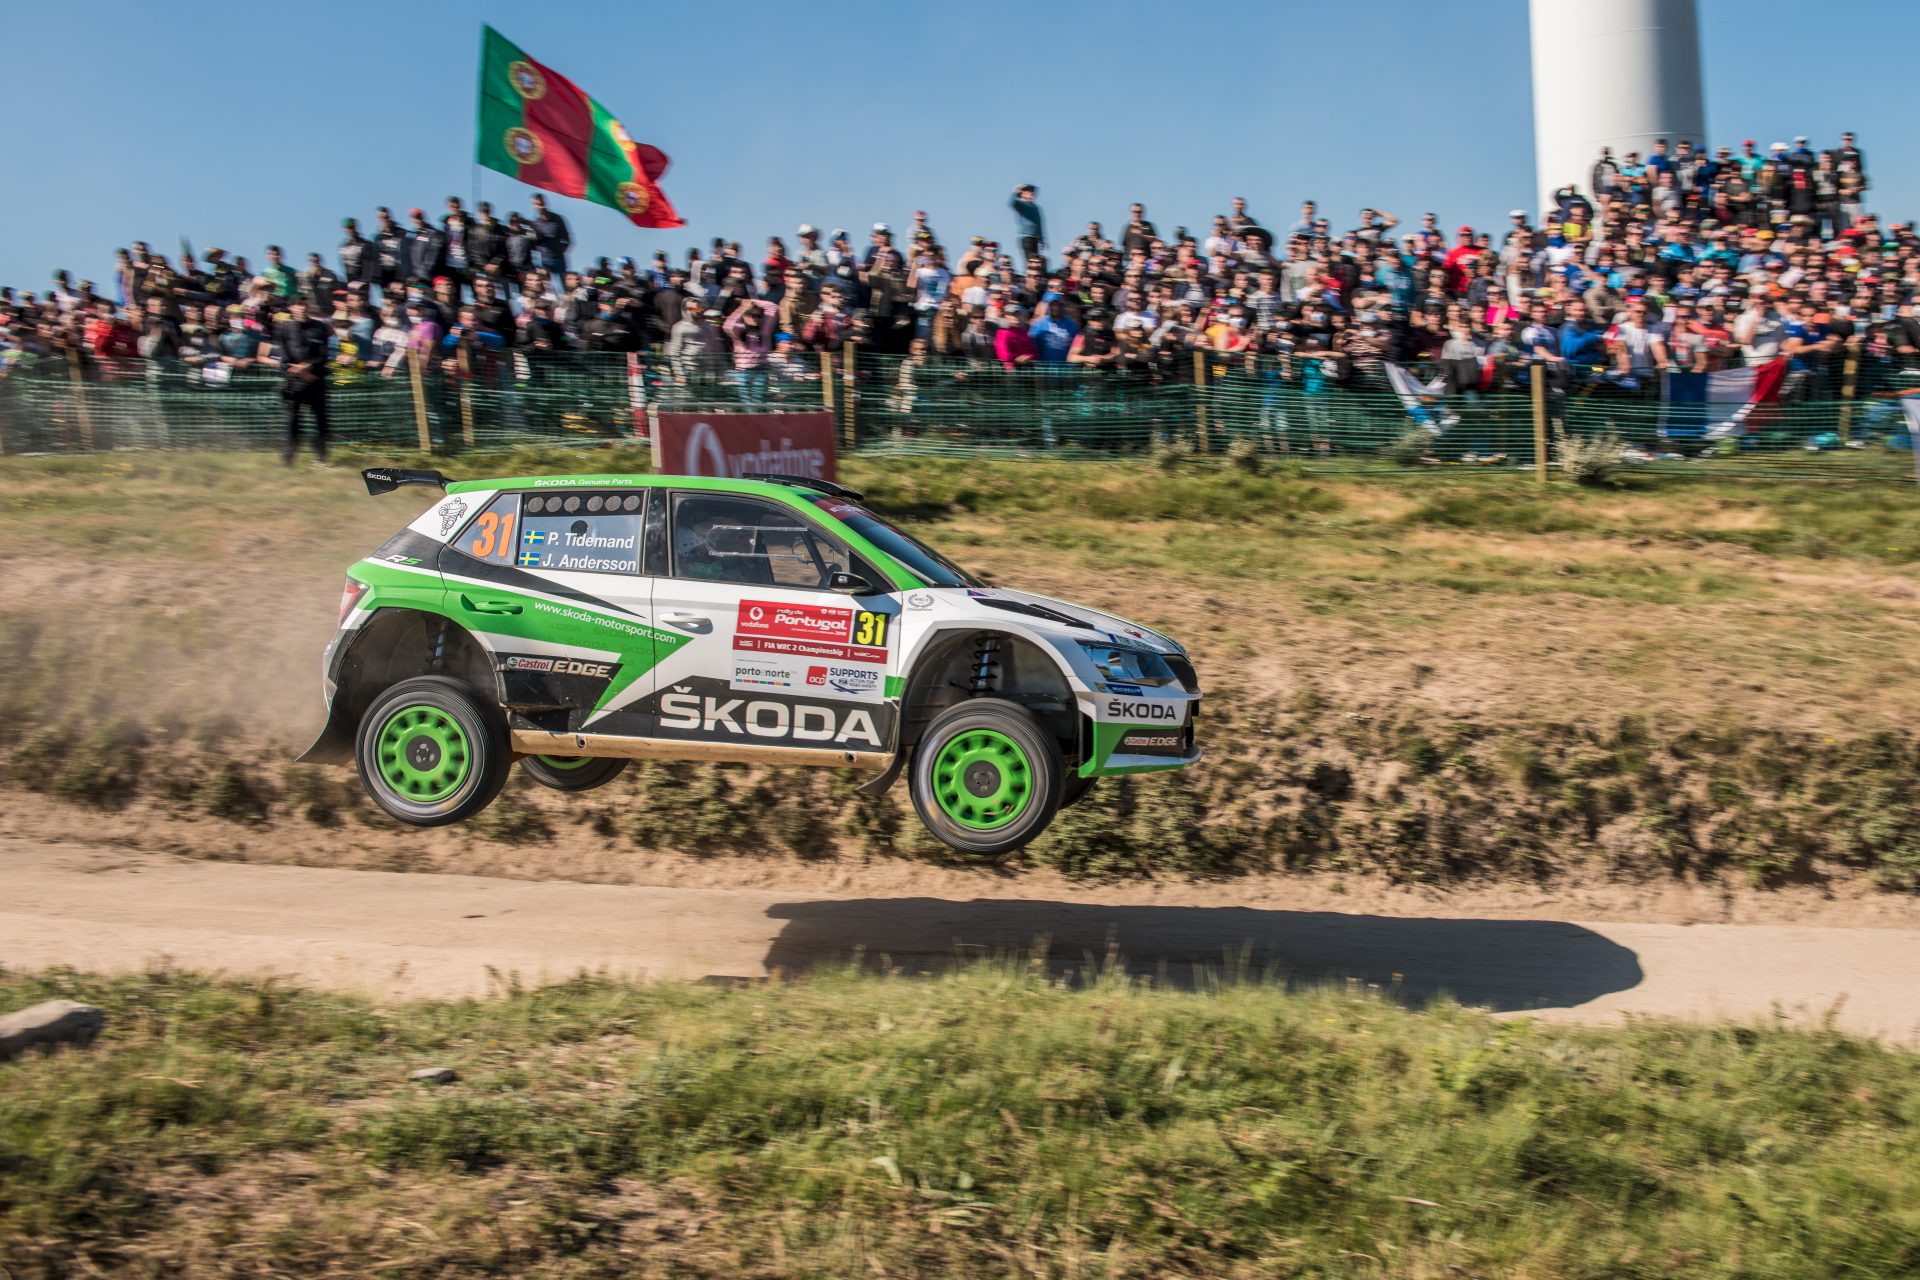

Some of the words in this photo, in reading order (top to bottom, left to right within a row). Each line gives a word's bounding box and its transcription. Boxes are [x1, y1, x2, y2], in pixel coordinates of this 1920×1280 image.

[472, 511, 516, 557] 31
[547, 531, 559, 545] P.
[564, 532, 635, 549] Tidemand
[385, 554, 423, 565] RS
[542, 554, 555, 567] J.
[558, 555, 637, 571] Andersson
[534, 600, 677, 644] www.skoda-motorsport.com
[740, 621, 770, 629] vodafone
[774, 614, 848, 631] Portugal
[856, 611, 887, 646] 31
[764, 641, 776, 649] FIA
[776, 642, 792, 650] WRC
[798, 645, 844, 656] Championship
[518, 658, 550, 670] Castrol
[551, 660, 613, 678] EDGE
[829, 667, 879, 680] SUPPORTS
[659, 685, 882, 747] ŠKODA
[1107, 698, 1177, 720] ŠKODA
[1148, 736, 1179, 746] EDGE
